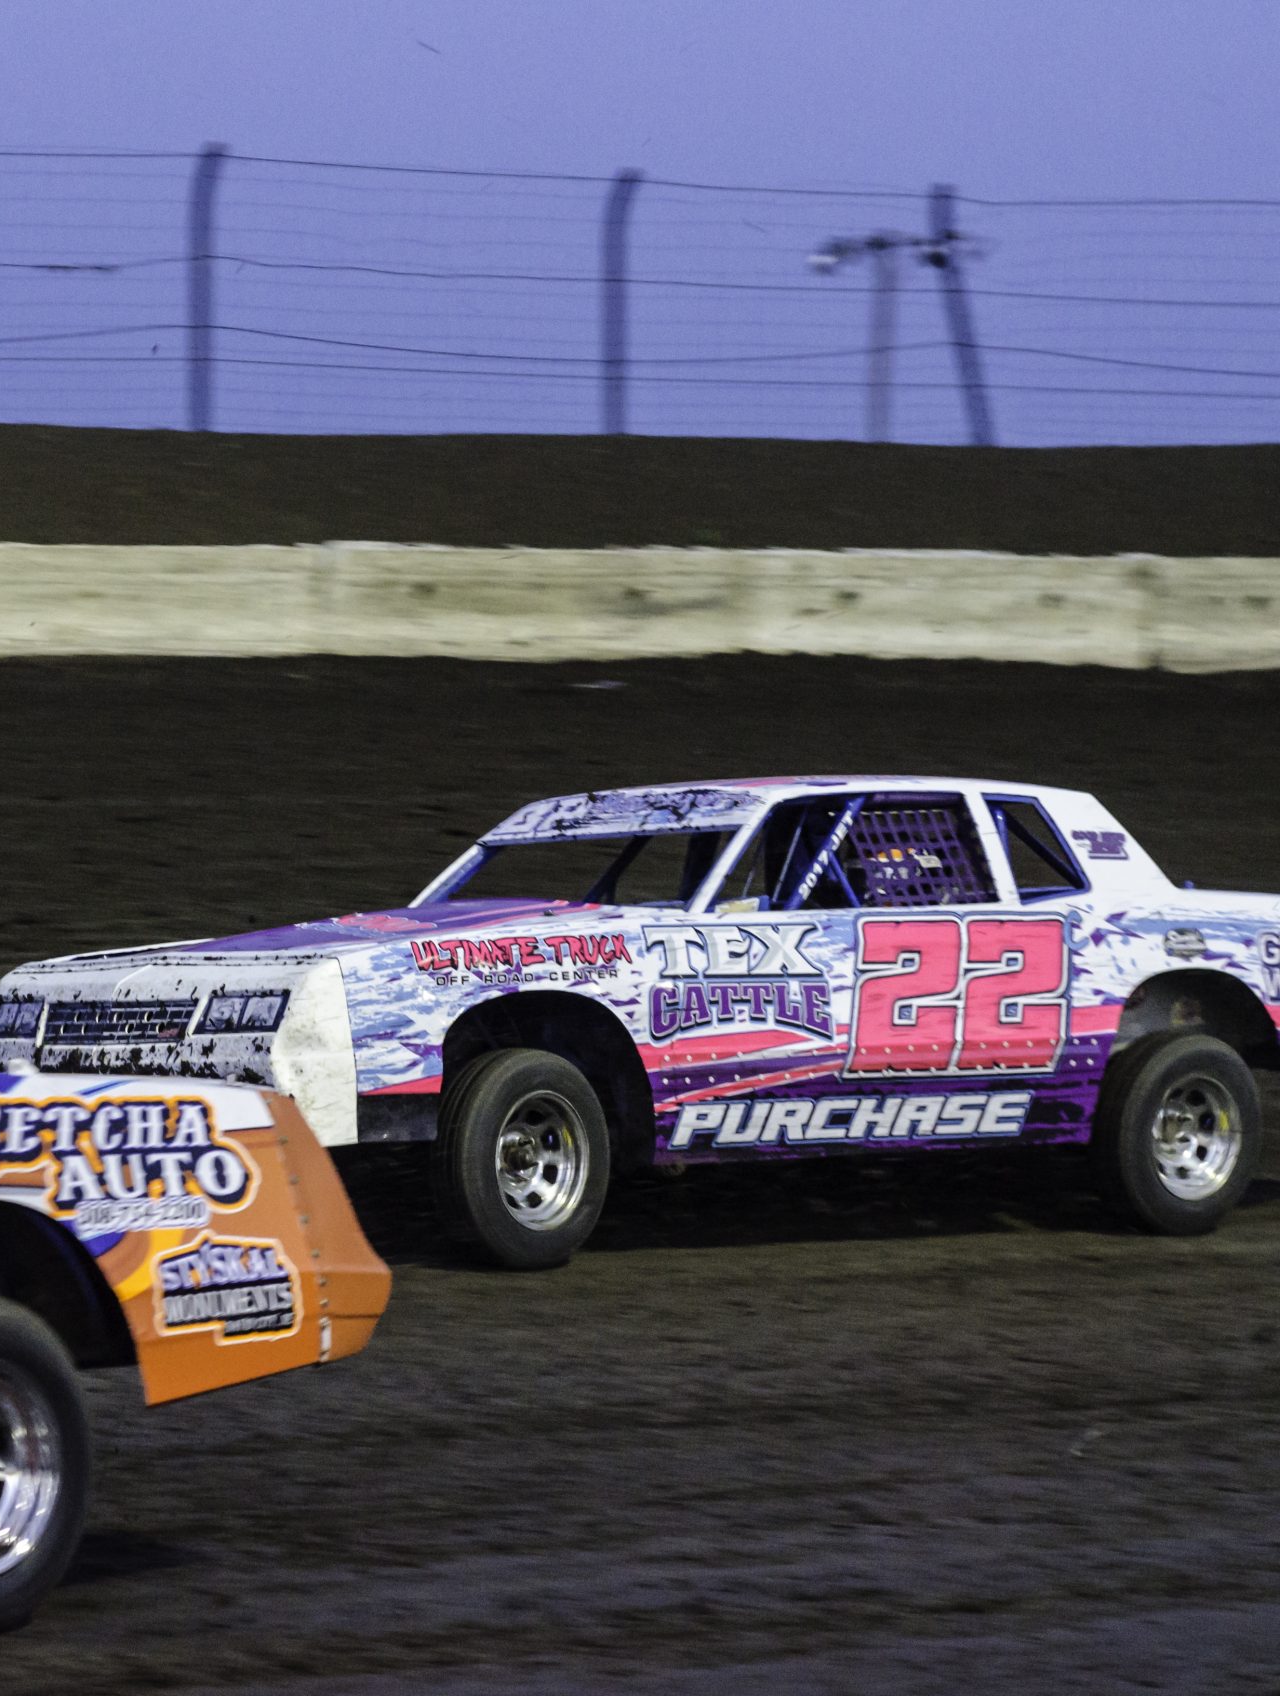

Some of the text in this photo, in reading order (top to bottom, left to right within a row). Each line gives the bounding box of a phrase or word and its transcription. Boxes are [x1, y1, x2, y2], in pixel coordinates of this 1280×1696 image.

[830, 809, 854, 852] JET
[410, 933, 633, 971] ULTIMATE TRUCK
[643, 924, 824, 977] TEX
[435, 969, 619, 986] OFF ROAD CENTER
[846, 914, 1068, 1077] 22
[649, 981, 835, 1041] CATTLE
[669, 1092, 1032, 1147] PURCHASE
[55, 1150, 249, 1201] AUTO
